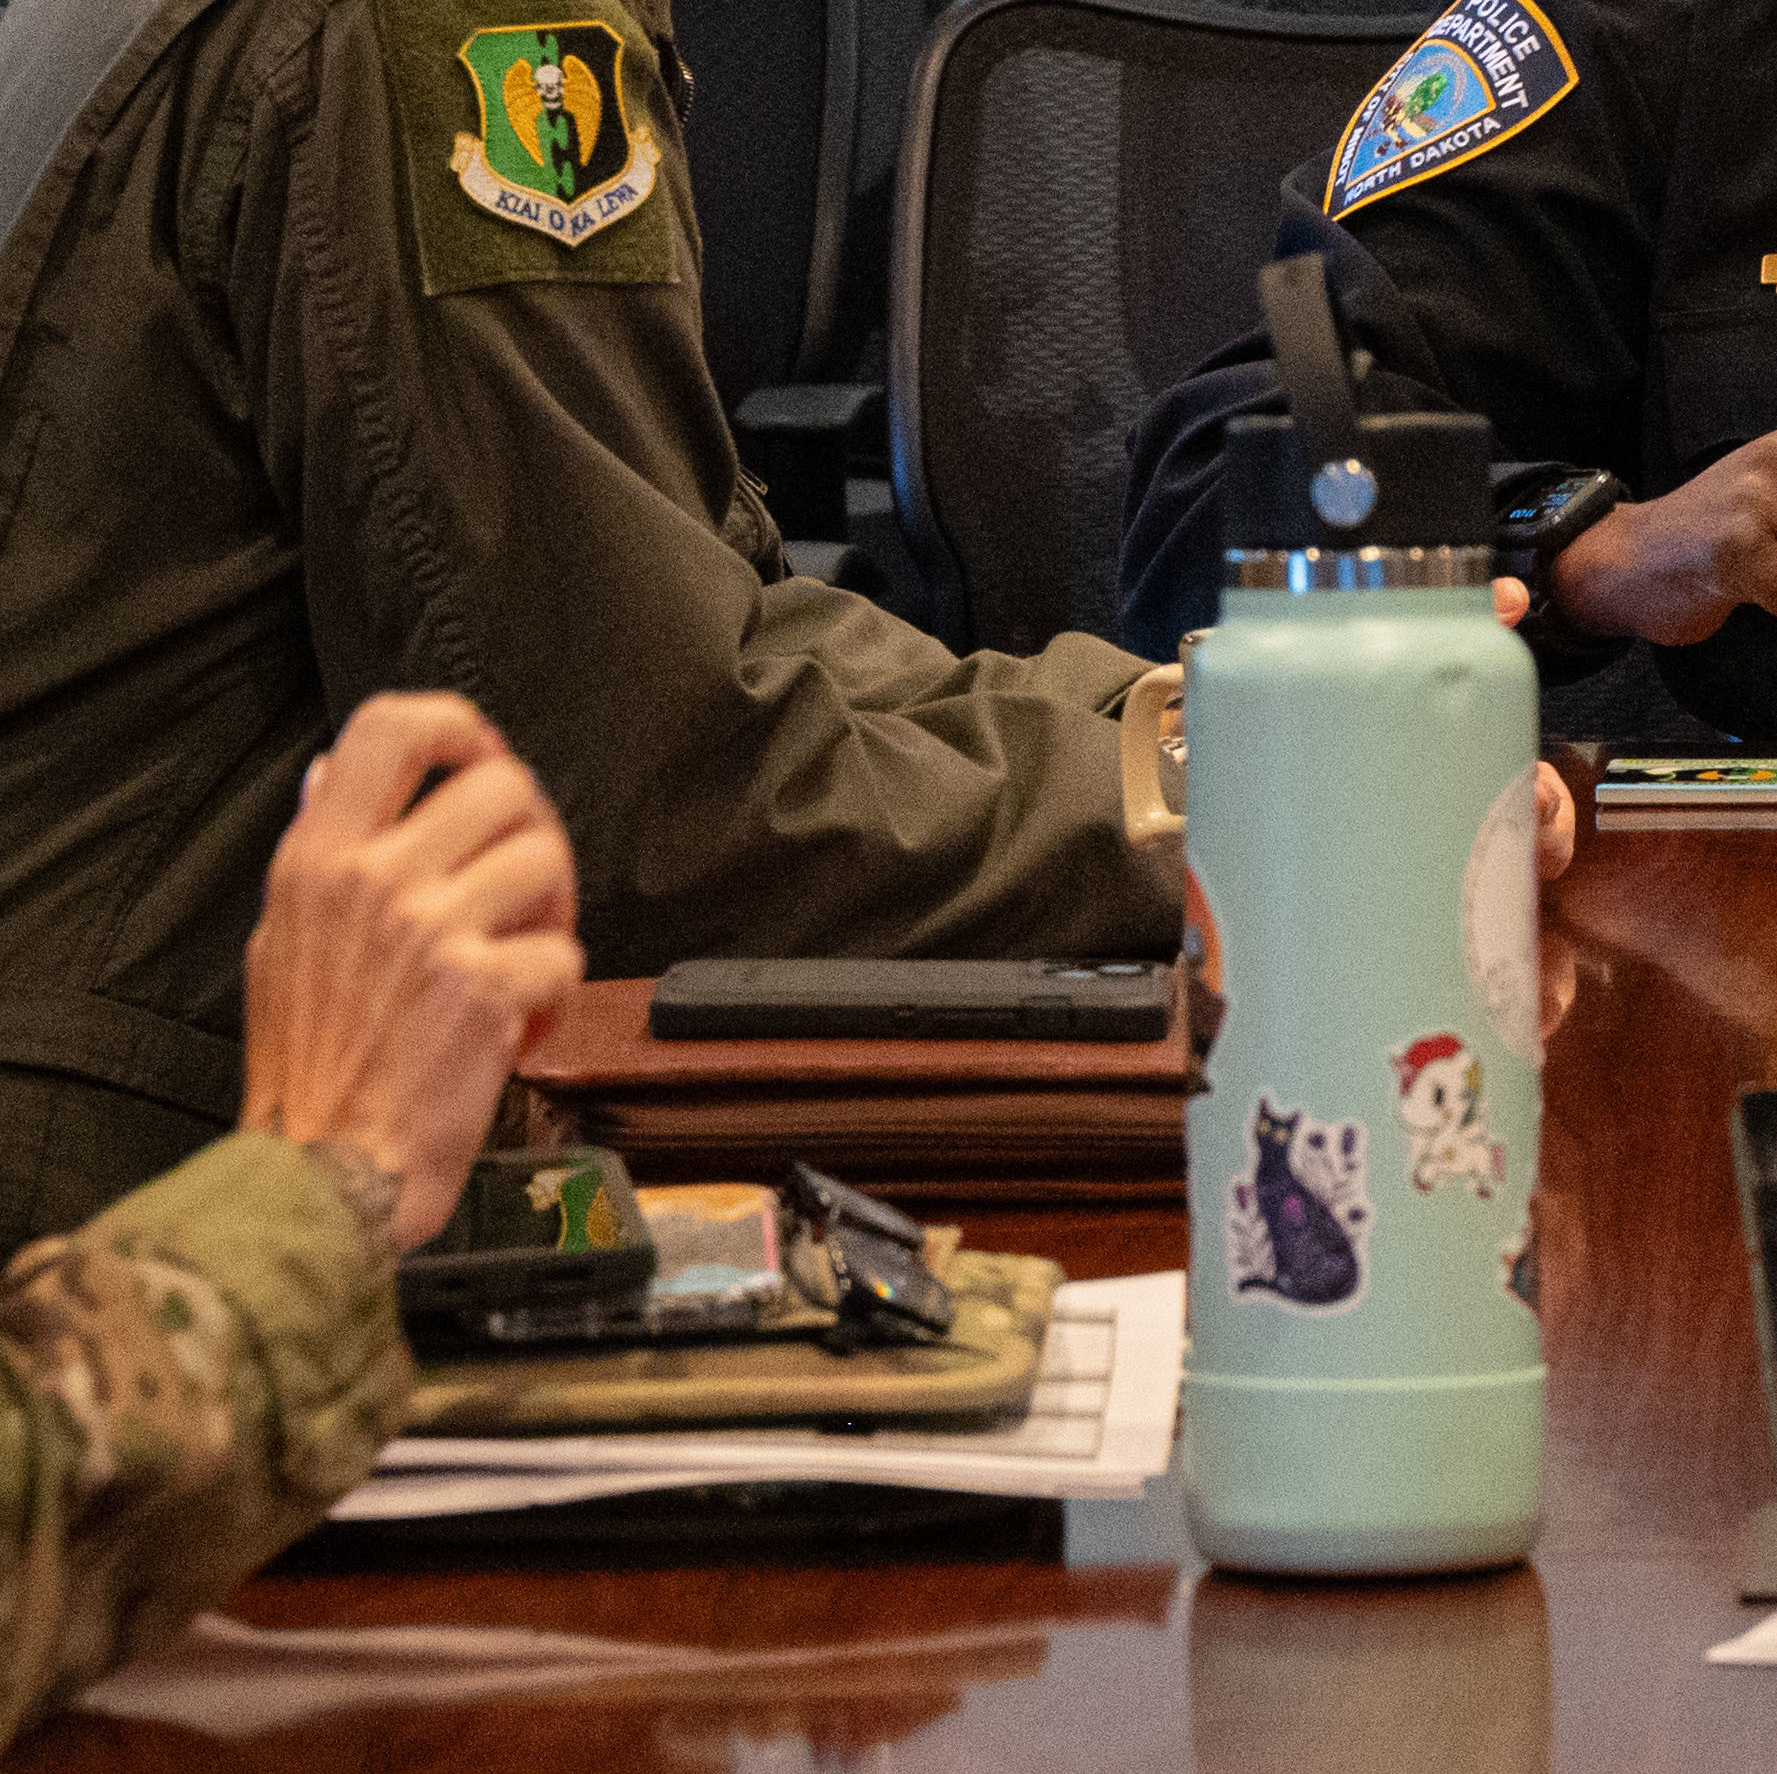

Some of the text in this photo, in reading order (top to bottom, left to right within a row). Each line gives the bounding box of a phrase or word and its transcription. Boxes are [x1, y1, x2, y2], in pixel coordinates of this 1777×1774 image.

[1428, 14, 1529, 109] DEPARTMENT
[1344, 116, 1501, 207] NORTH DAKOTA
[495, 183, 639, 238] KIAI O KA LEWA
